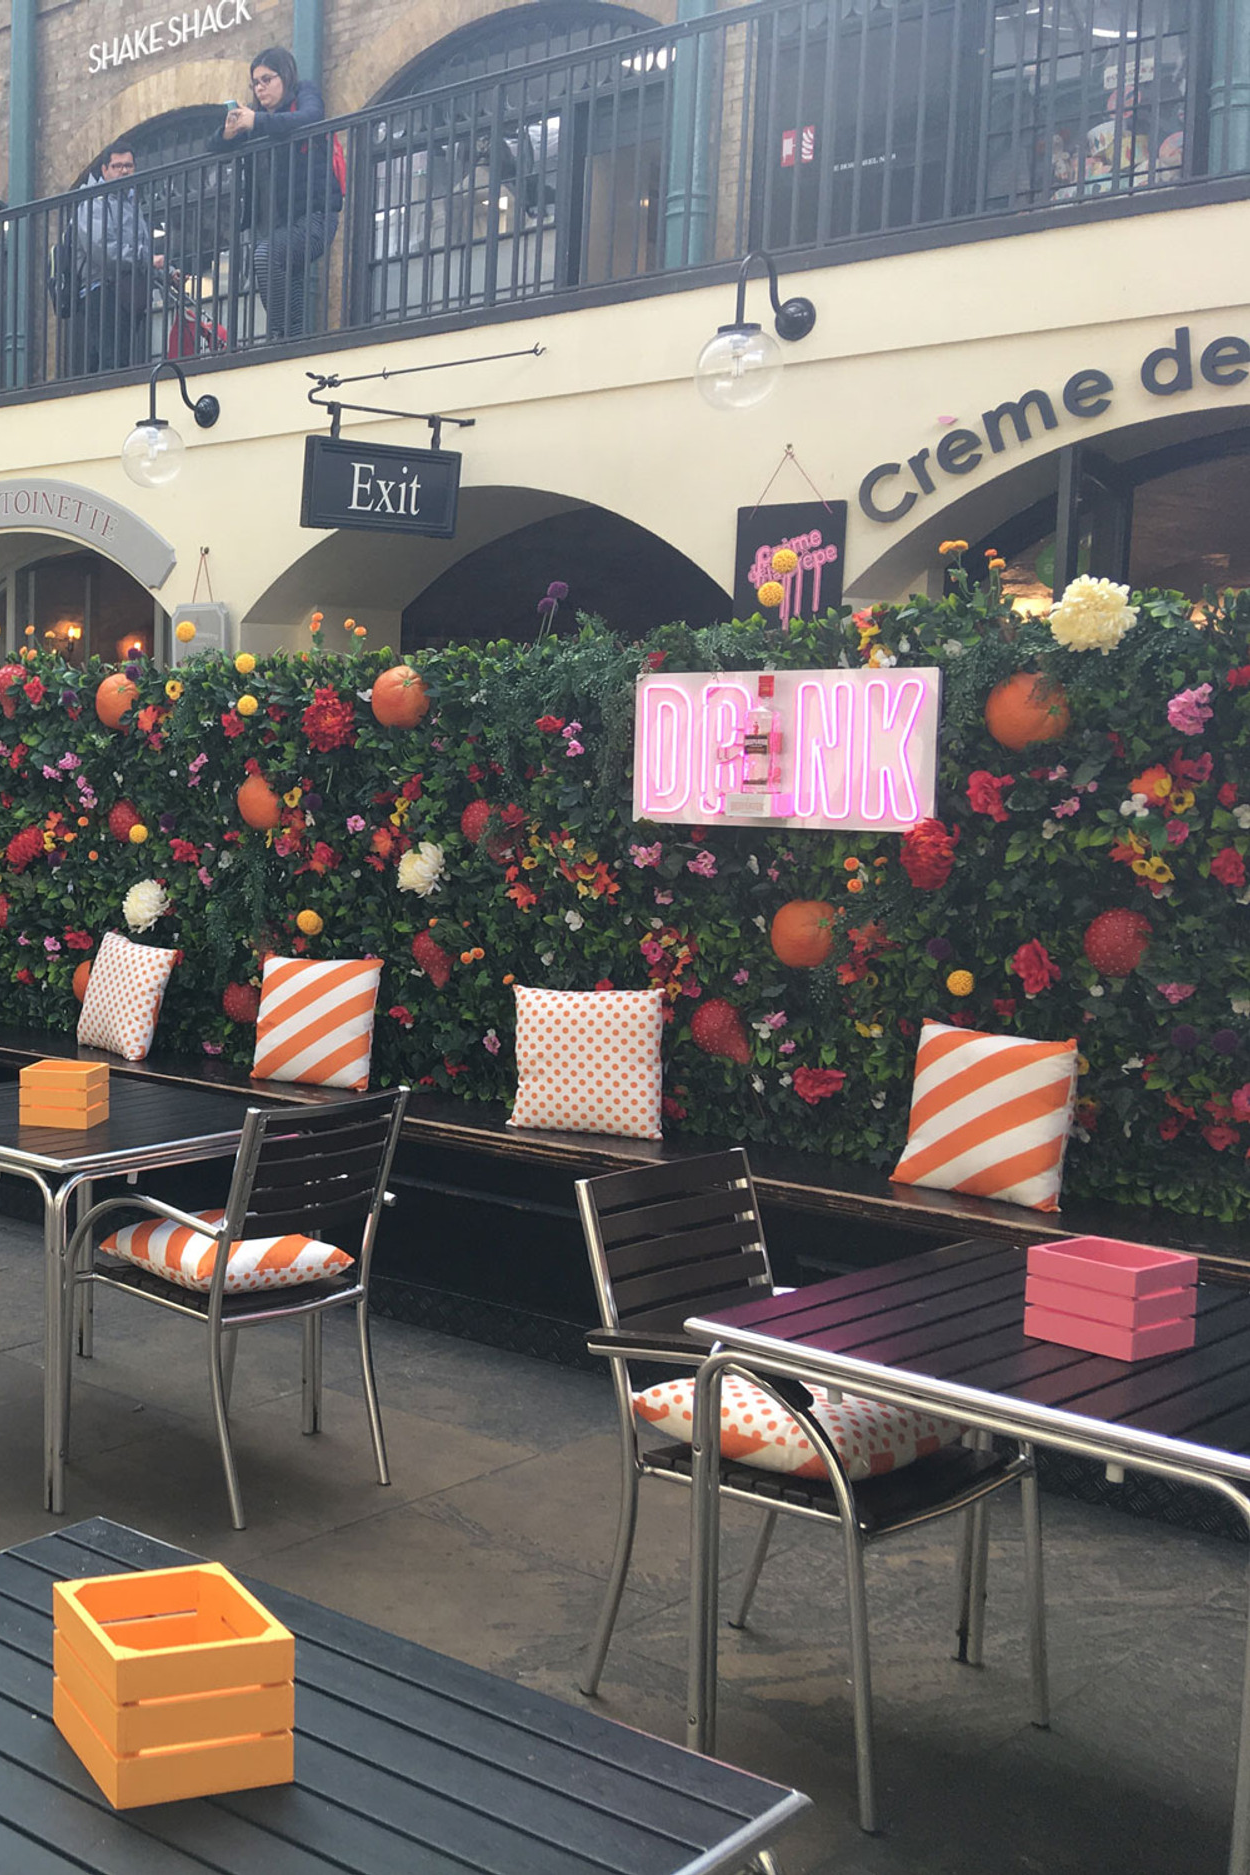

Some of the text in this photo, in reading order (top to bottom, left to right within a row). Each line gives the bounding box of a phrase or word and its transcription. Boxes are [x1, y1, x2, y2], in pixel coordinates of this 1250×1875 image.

[88, 0, 252, 74] SHAKE SHACK
[1140, 326, 1250, 396] de
[348, 462, 422, 516] Exit
[641, 680, 925, 823] DRNK
